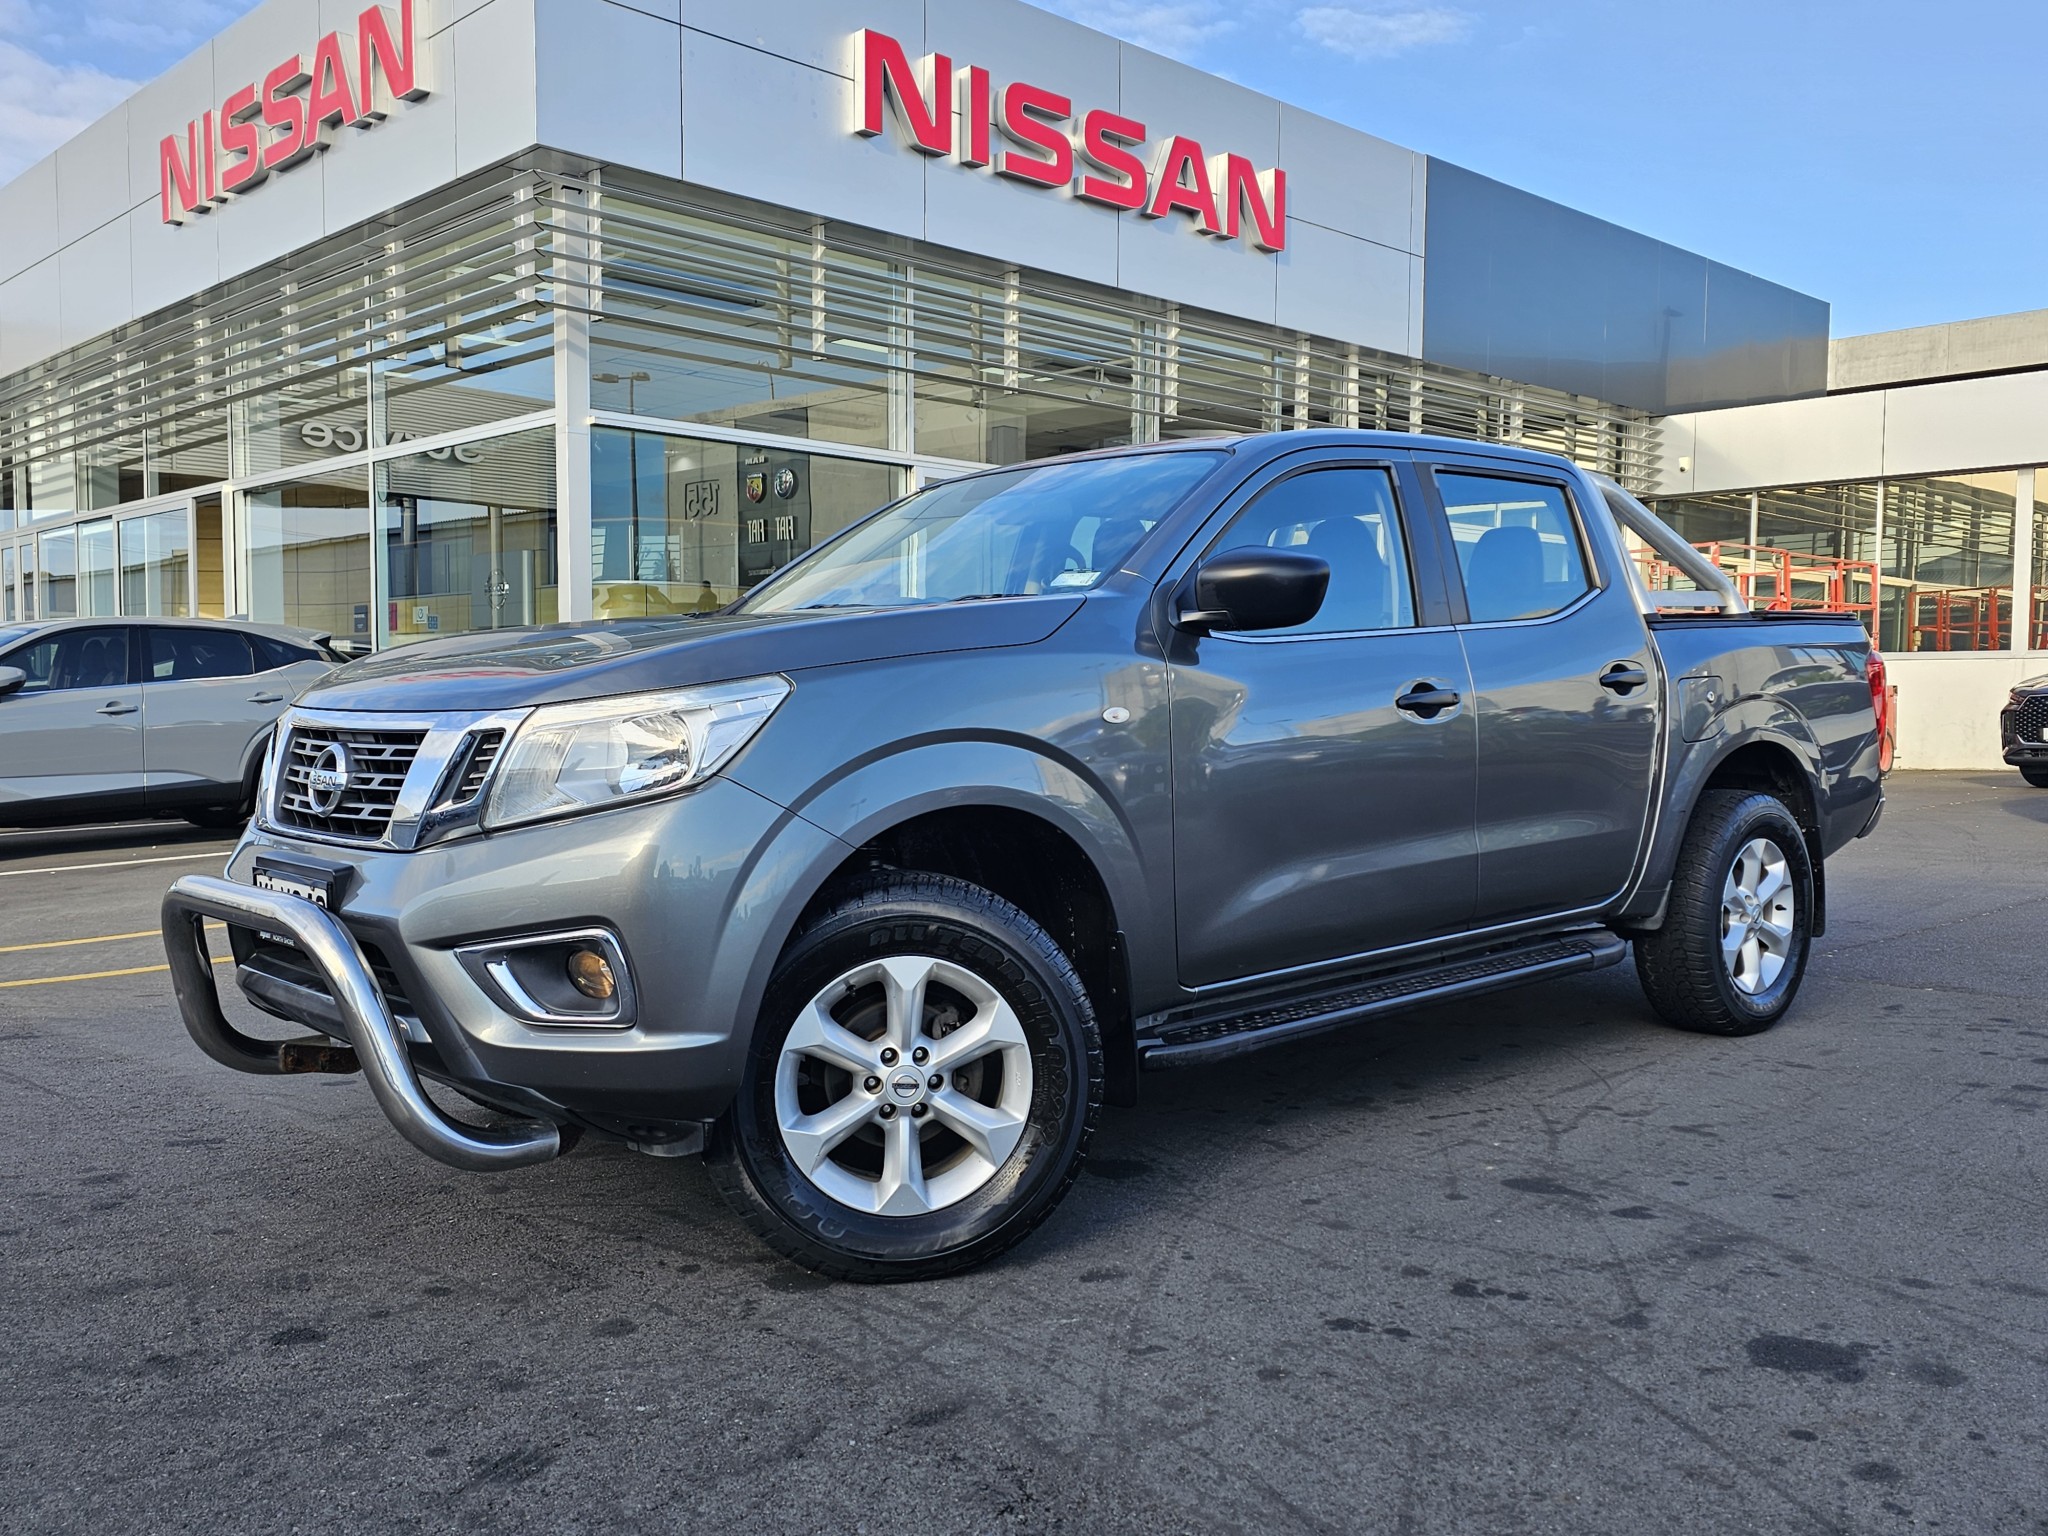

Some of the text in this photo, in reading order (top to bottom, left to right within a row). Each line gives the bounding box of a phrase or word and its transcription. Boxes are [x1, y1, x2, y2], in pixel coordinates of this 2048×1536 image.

[160, 0, 415, 224] NISSAN
[858, 27, 1286, 252] NISSAN
[311, 774, 337, 787] SSAN
